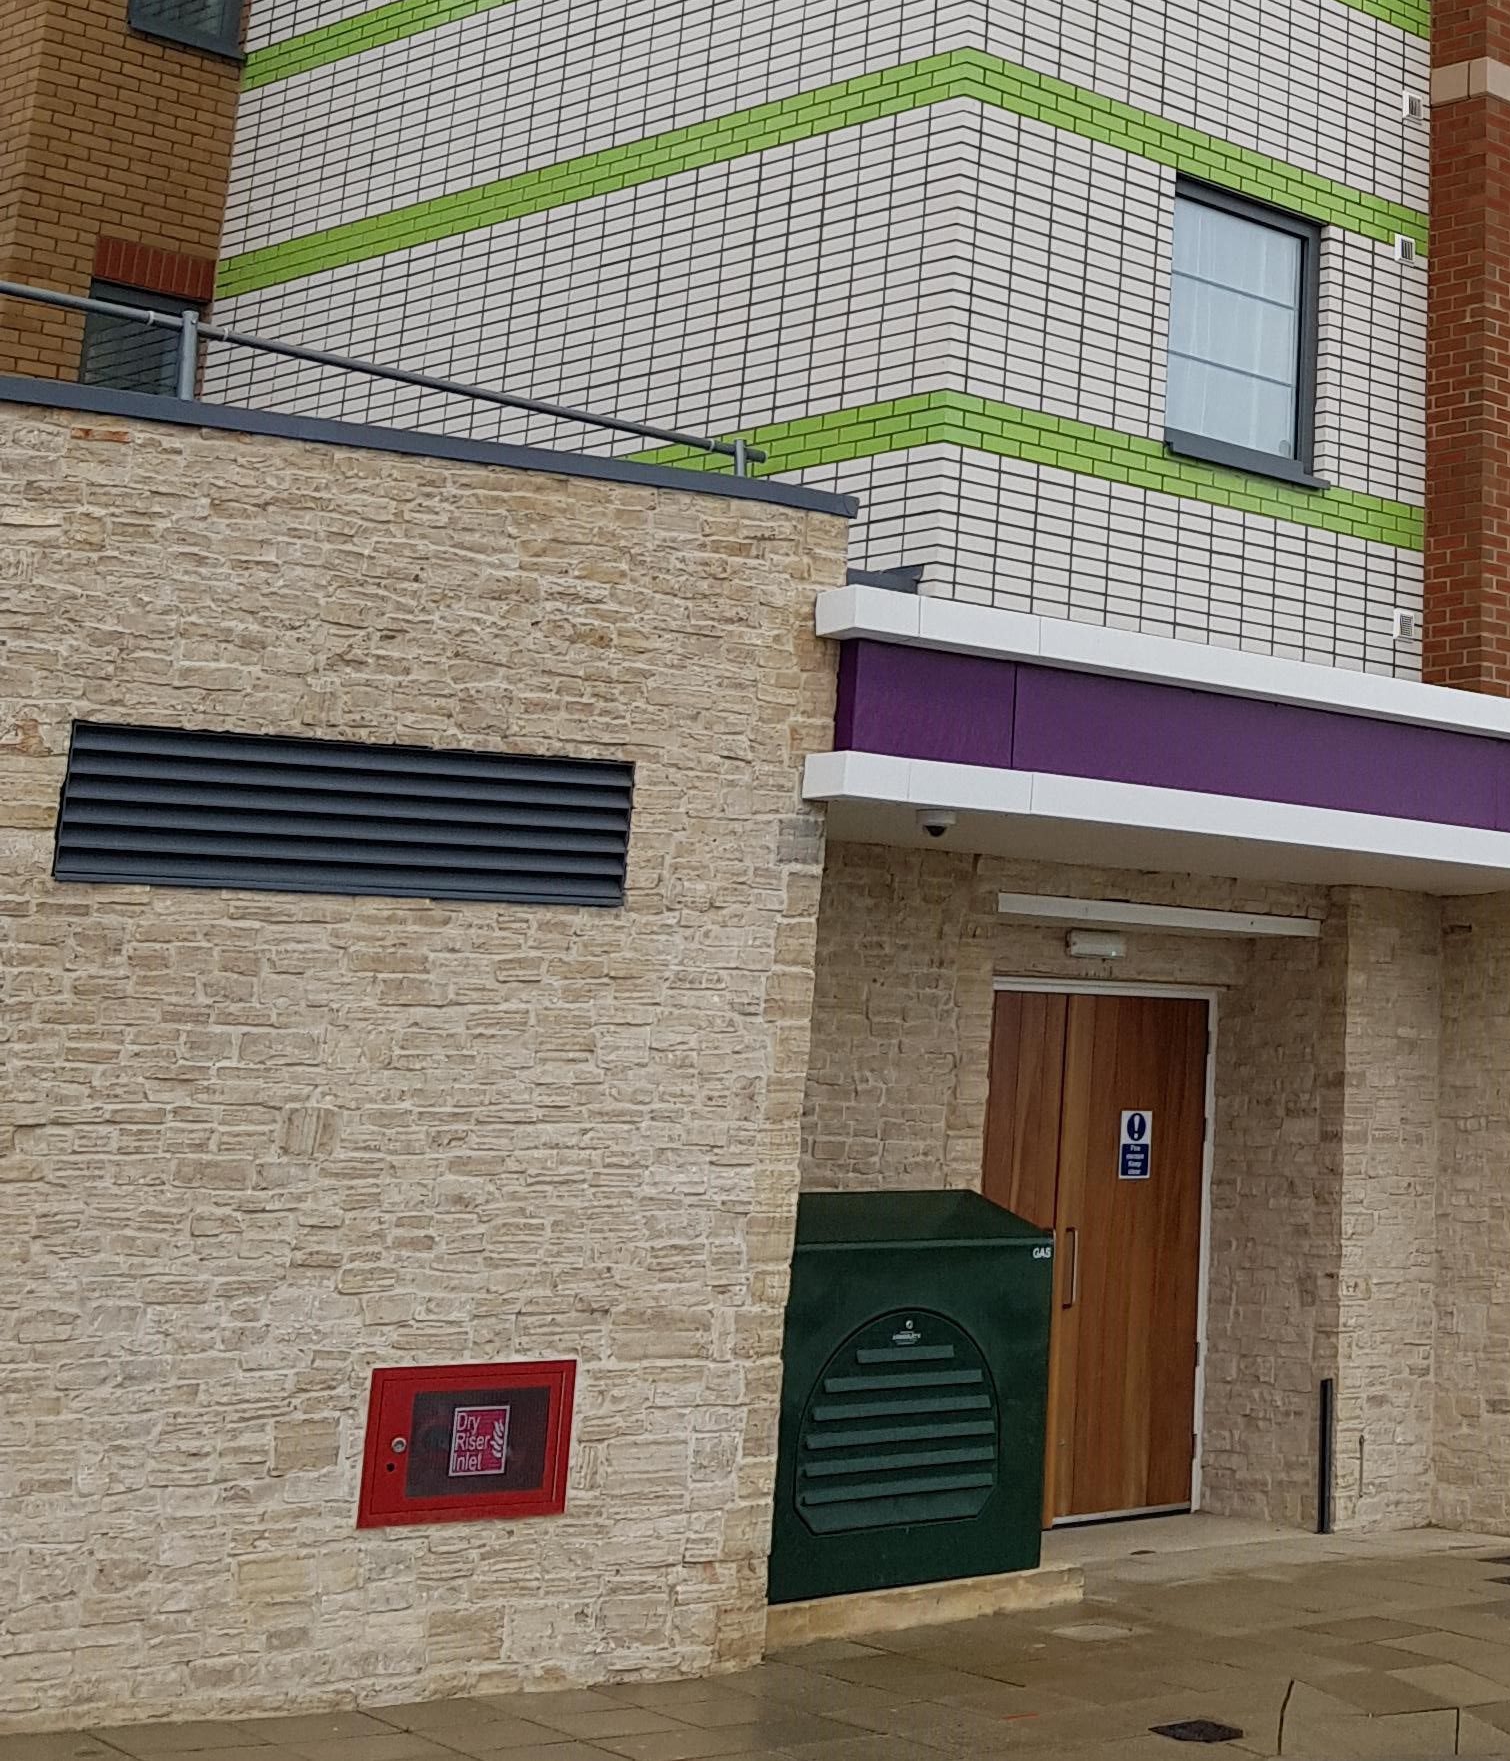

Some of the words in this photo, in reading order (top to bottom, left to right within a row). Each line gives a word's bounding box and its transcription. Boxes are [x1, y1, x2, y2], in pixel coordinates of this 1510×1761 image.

[1032, 1247, 1052, 1259] GAS
[457, 1412, 481, 1435] Dry
[454, 1432, 491, 1451] Riser
[452, 1451, 483, 1472] Inlet
